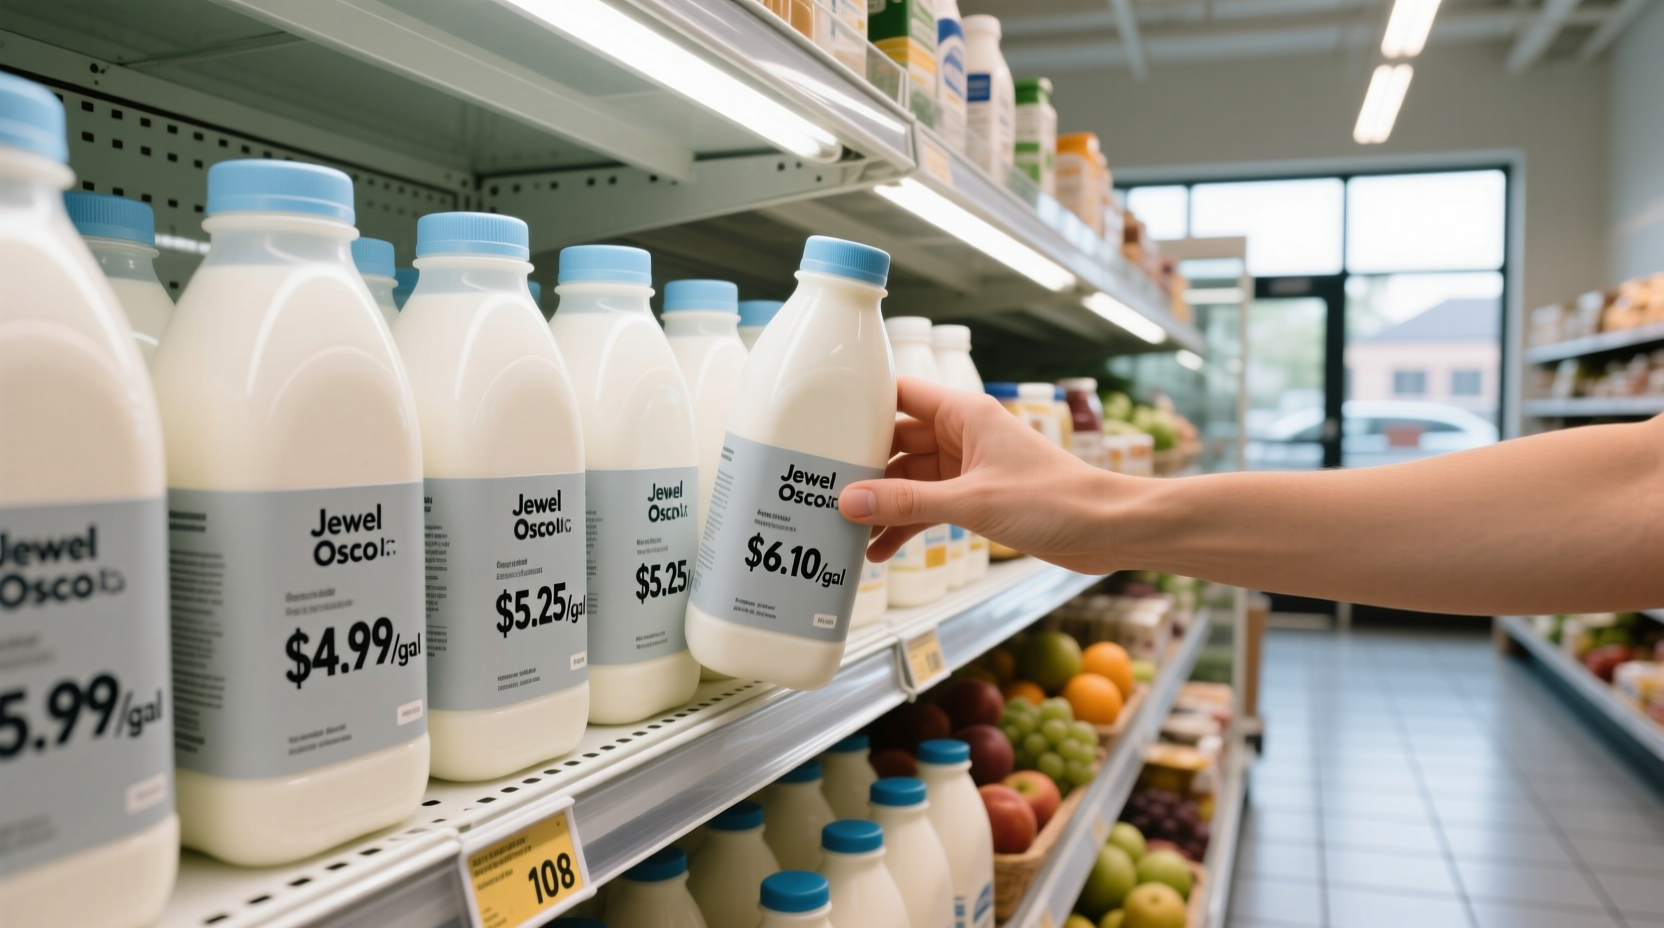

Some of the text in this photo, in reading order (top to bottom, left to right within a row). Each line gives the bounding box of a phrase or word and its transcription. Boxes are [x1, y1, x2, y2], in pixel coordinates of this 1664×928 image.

[647, 479, 683, 502] Jewel
[779, 463, 837, 490] Jewel
[311, 503, 382, 538] Jewel
[512, 489, 562, 517] Jewel
[744, 532, 847, 588] $6.10/gal
[495, 582, 586, 638] $5.25/gal
[285, 616, 421, 690] $4.99/gal
[528, 852, 575, 905] 108
